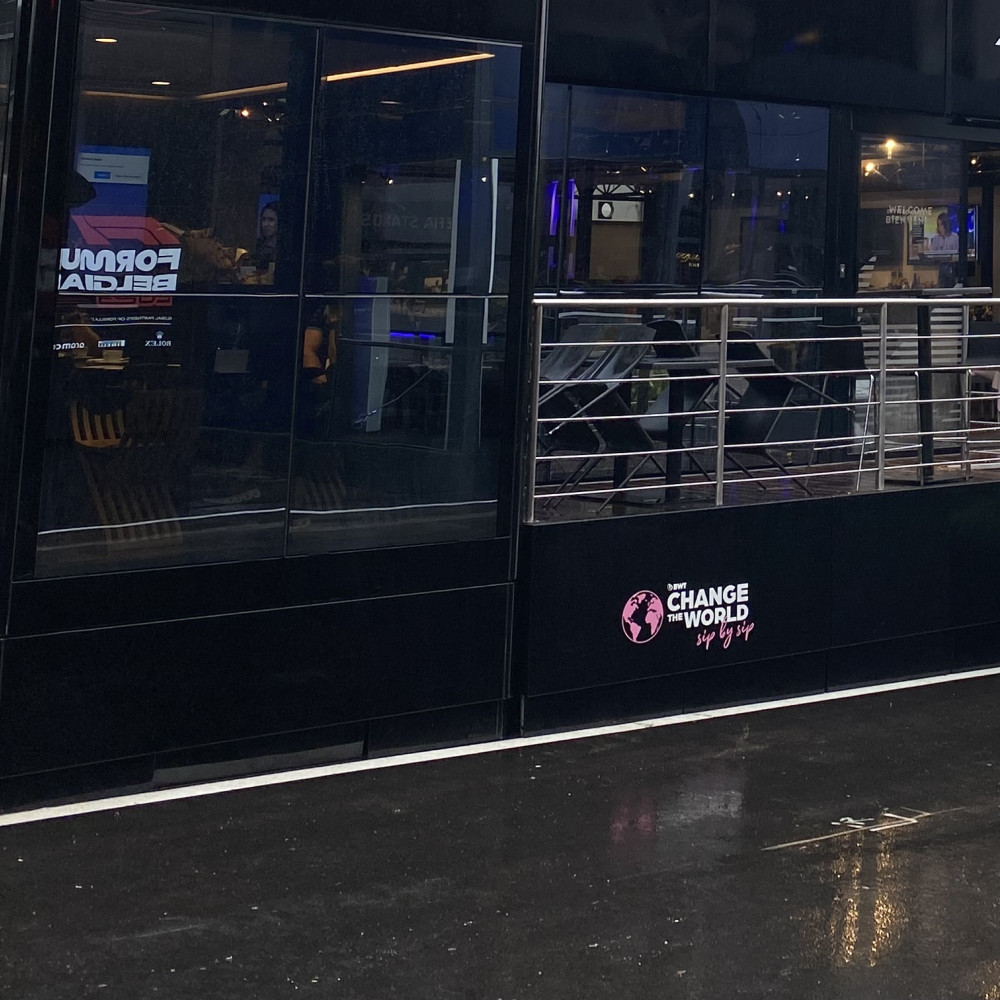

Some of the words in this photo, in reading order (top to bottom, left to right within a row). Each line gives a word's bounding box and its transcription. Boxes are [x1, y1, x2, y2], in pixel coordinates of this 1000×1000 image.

[667, 583, 749, 612] CHANGE
[667, 612, 684, 623] THE
[684, 604, 749, 629] WORLD
[696, 629, 716, 650] sip
[719, 617, 734, 649] by
[736, 621, 755, 642] sip
